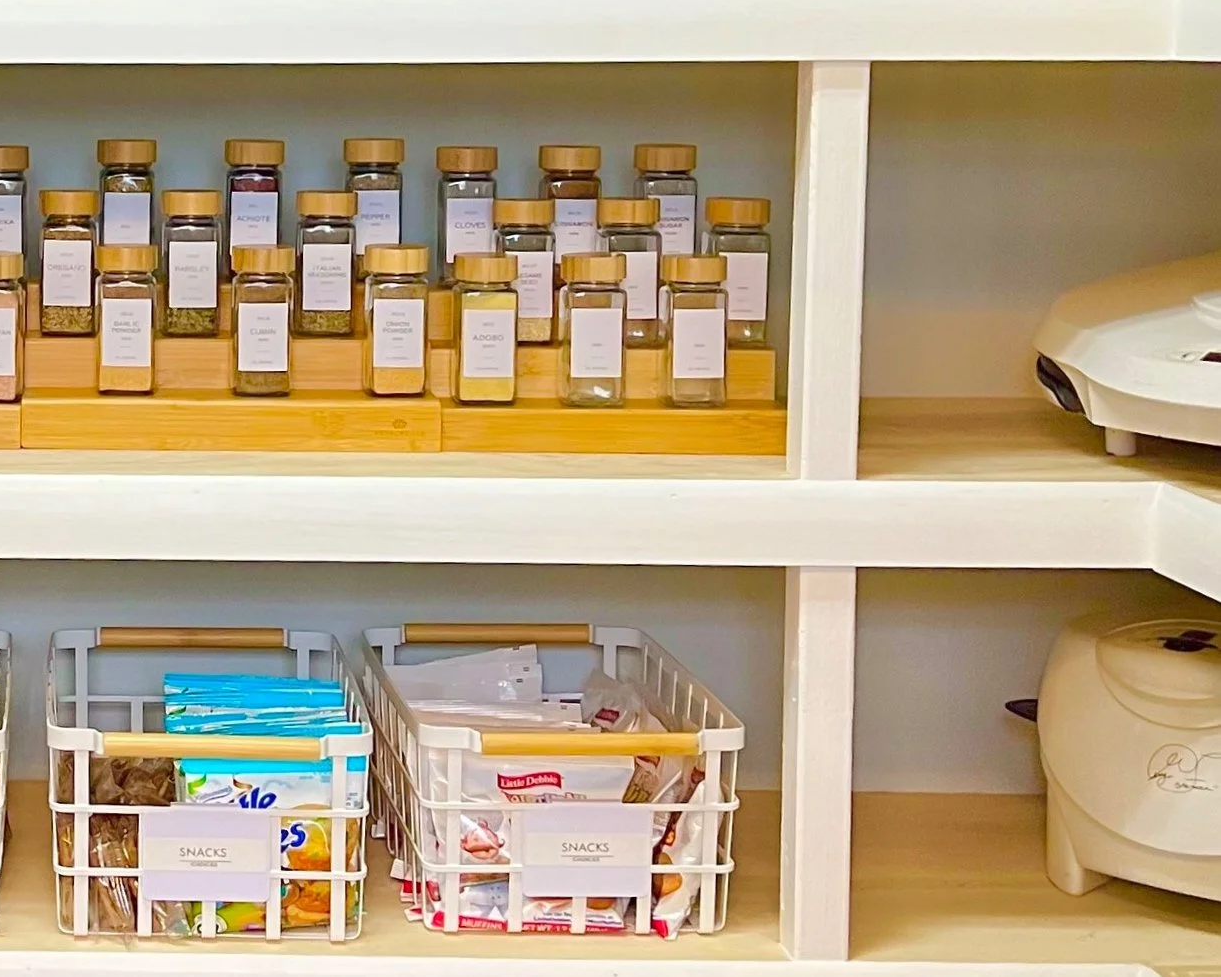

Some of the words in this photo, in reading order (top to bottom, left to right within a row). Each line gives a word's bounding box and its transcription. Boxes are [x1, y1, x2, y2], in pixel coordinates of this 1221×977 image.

[453, 221, 487, 230] CLOVES
[471, 333, 506, 342] ADOBO
[499, 779, 526, 789] Little
[526, 773, 559, 786] Debbie
[179, 847, 228, 858] SNACKS
[561, 842, 611, 853] SNACKS
